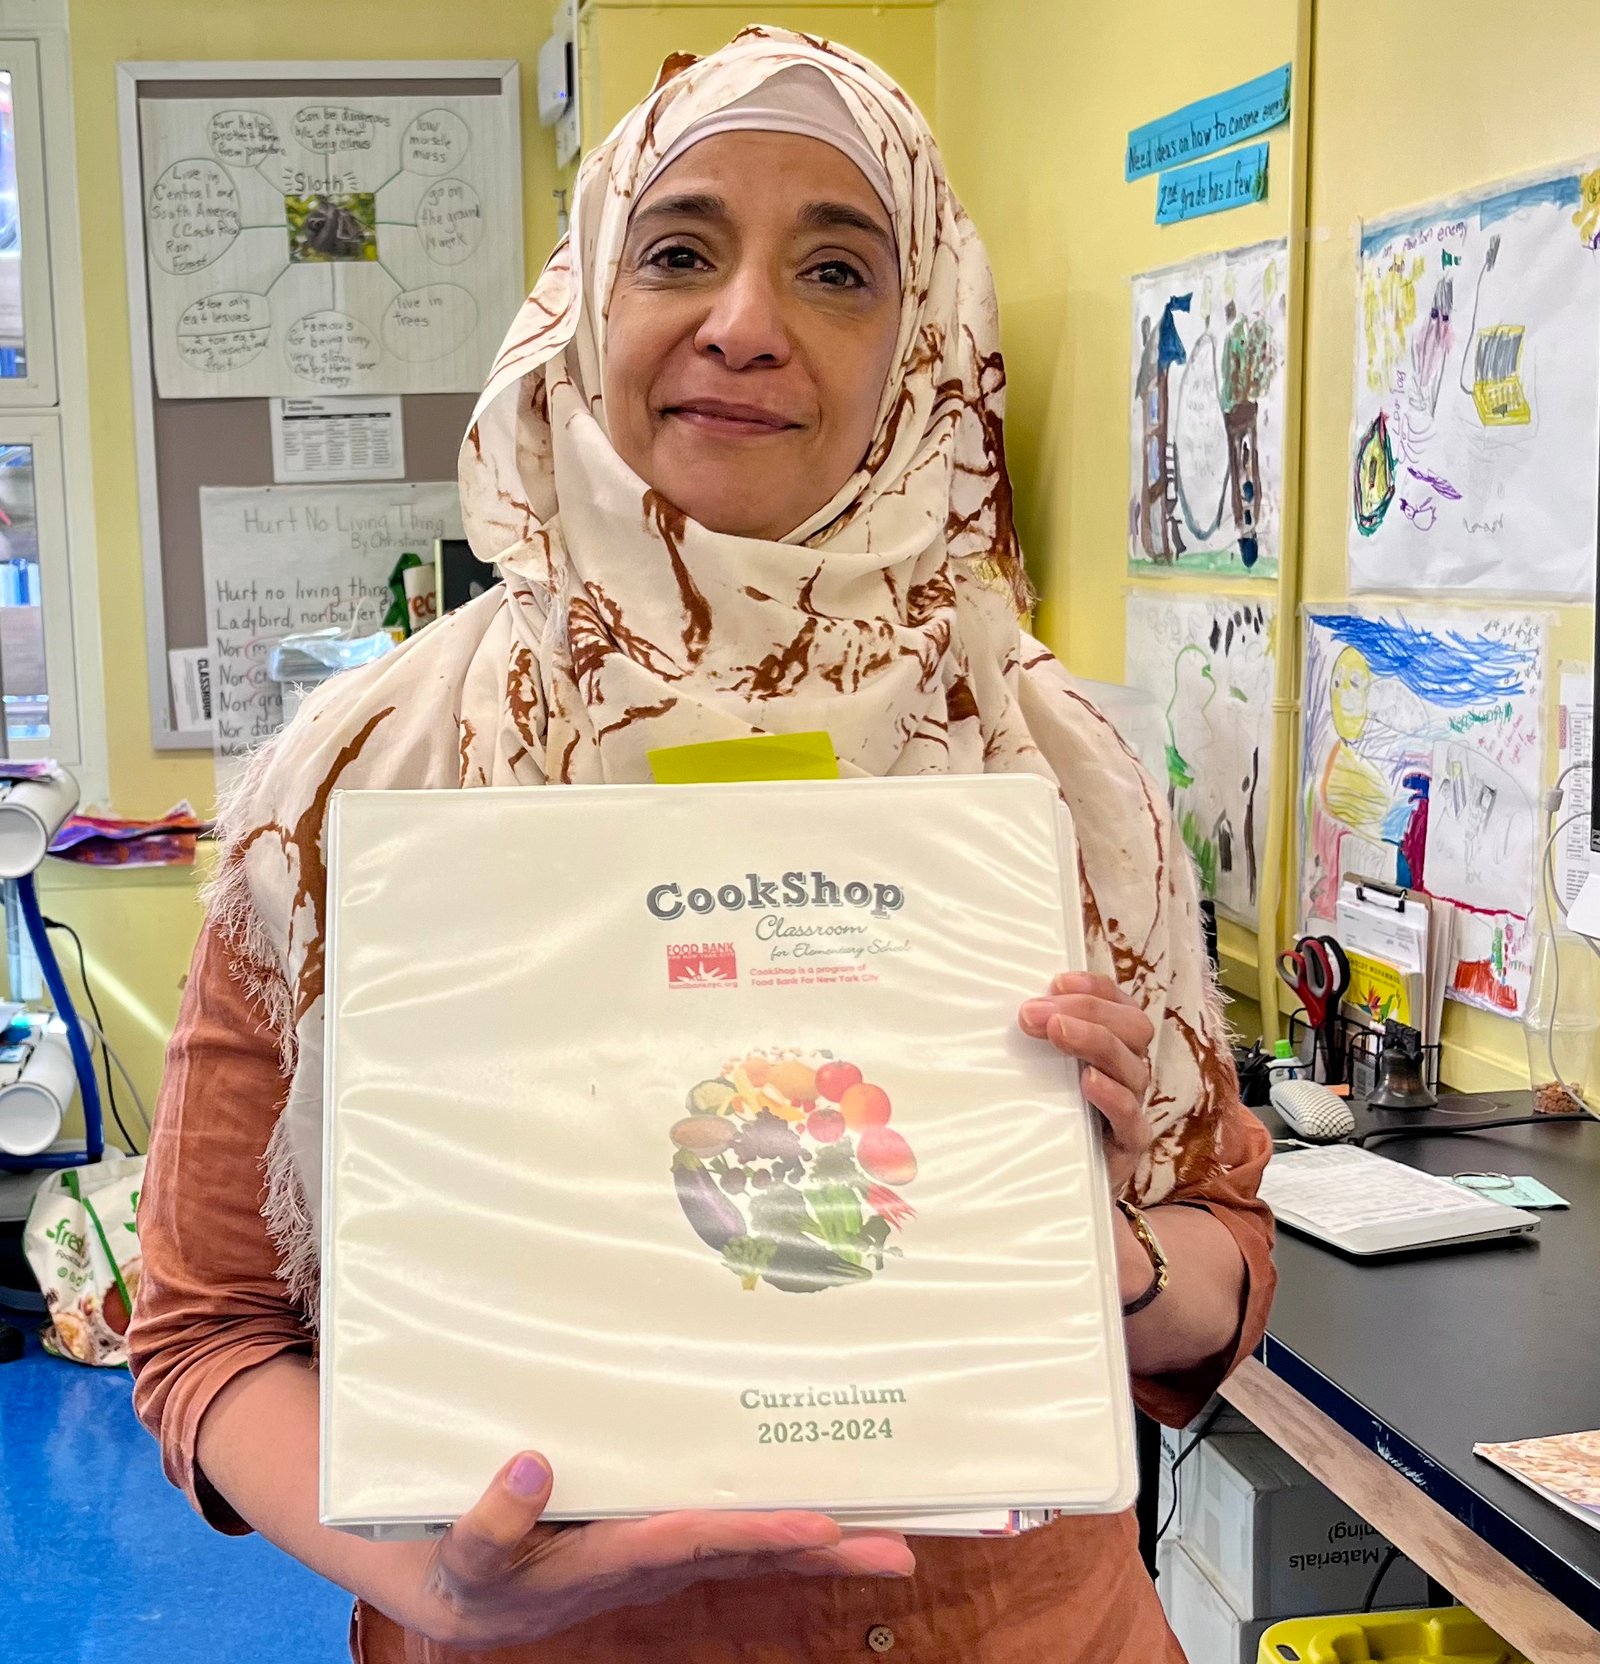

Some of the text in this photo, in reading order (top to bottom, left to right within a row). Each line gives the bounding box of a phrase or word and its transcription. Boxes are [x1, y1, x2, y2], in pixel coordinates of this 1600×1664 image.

[296, 110, 318, 123] Can
[323, 108, 337, 121] be
[317, 124, 331, 137] of
[1129, 139, 1151, 173] Need
[1154, 135, 1177, 163] ideas
[1178, 137, 1189, 153] on
[1190, 120, 1211, 148] how
[1214, 112, 1228, 141] to
[294, 173, 344, 192] Sloth
[1157, 182, 1178, 216] 2nd
[1181, 174, 1206, 218] grade
[1209, 171, 1223, 203] has
[1226, 179, 1232, 200] a
[396, 298, 444, 309] live in
[302, 317, 353, 332] Famous
[392, 311, 430, 328] trees
[244, 503, 445, 539] Hurt No Living Thing
[216, 579, 258, 602] Hurt
[265, 588, 286, 600] no
[296, 579, 341, 607] living
[216, 603, 386, 636] Ladybird, nor butterf
[216, 638, 242, 658] Nor
[220, 665, 245, 686] Nor
[220, 692, 247, 712] Nor
[219, 720, 243, 738] Nor
[646, 871, 905, 921] CookShop
[755, 914, 867, 941] Classroom
[666, 942, 735, 955] FOOD BANK
[770, 939, 911, 961] for Elementary School
[750, 967, 795, 977] CookShop
[798, 966, 805, 974] is
[815, 965, 854, 975] program
[752, 978, 774, 986] Food
[776, 977, 798, 985] Bank
[801, 976, 814, 984] For
[862, 974, 879, 982] City
[740, 1385, 906, 1409] Curriculum
[758, 1417, 892, 1443] 2023-2024
[1289, 1548, 1379, 1571] Materials
